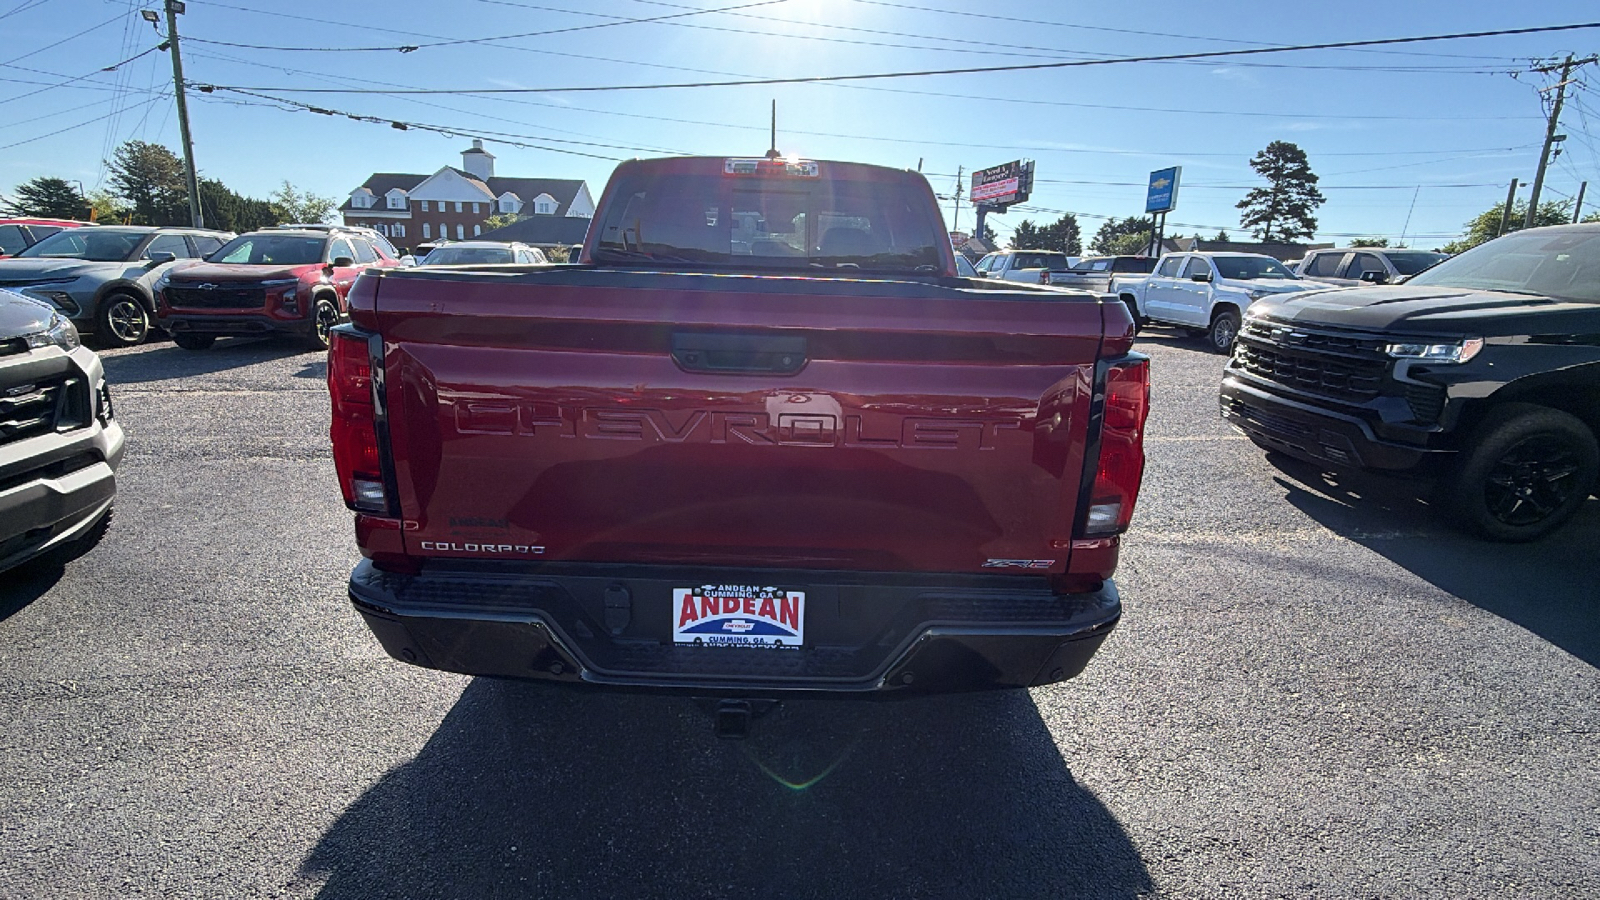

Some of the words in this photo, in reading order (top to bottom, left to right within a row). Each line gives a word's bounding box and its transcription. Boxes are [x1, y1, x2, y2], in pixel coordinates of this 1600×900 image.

[453, 404, 1022, 452] CHEVROLET
[421, 541, 545, 554] COLORADO
[981, 558, 1056, 568] ZR2
[704, 590, 756, 599] CUMMING,
[678, 593, 800, 632] ANDEAN
